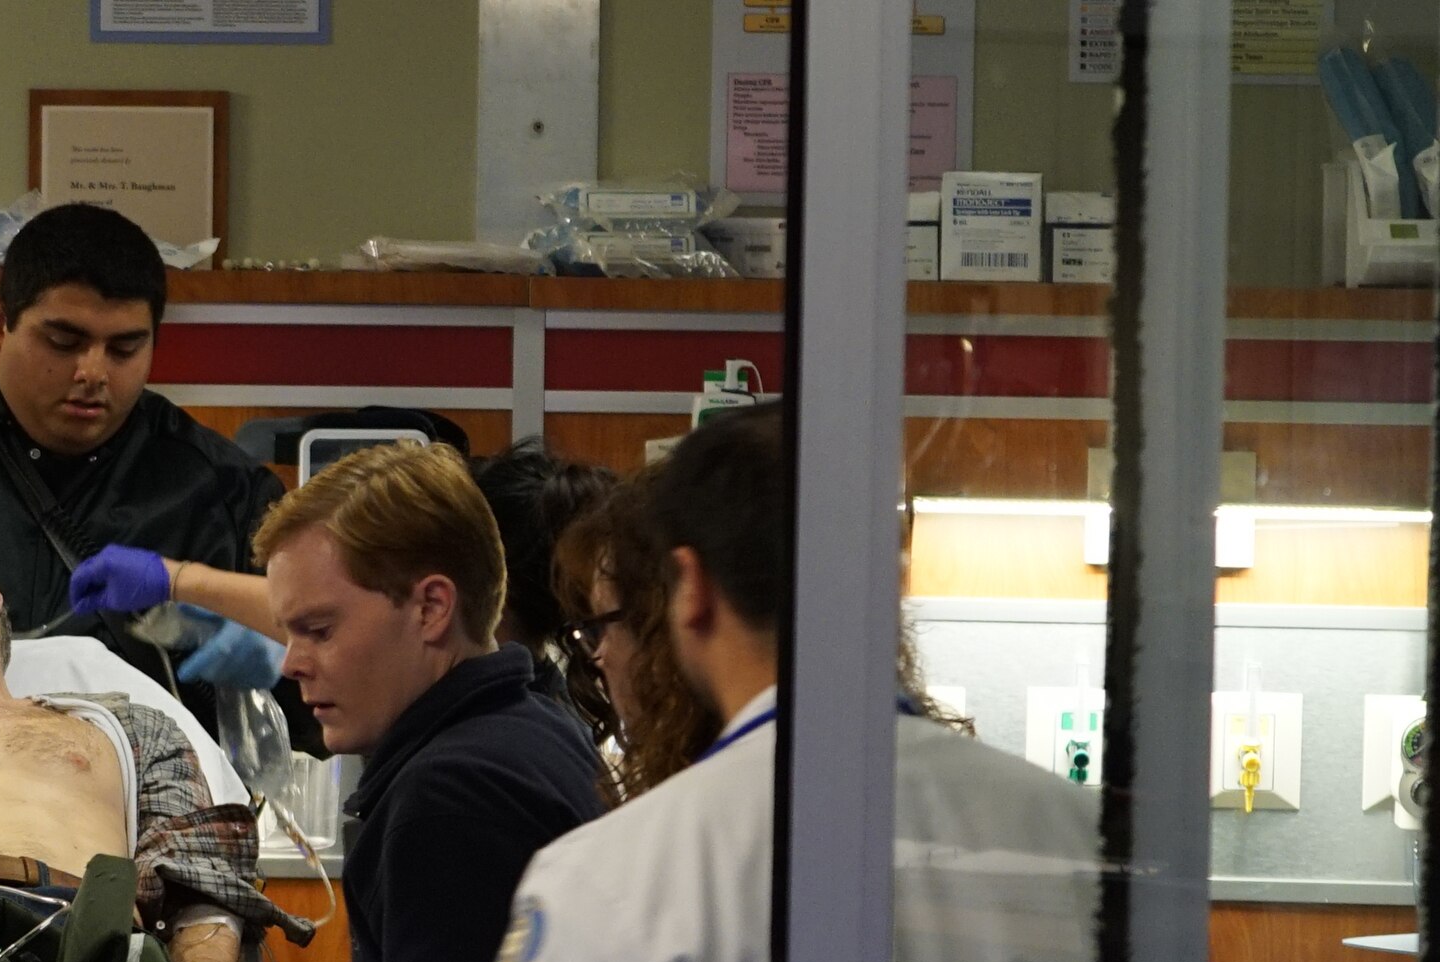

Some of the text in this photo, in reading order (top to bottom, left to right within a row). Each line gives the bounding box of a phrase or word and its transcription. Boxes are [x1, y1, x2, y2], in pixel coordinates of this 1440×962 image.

[70, 182, 176, 192] Mr. & Mrs. T. Baughman
